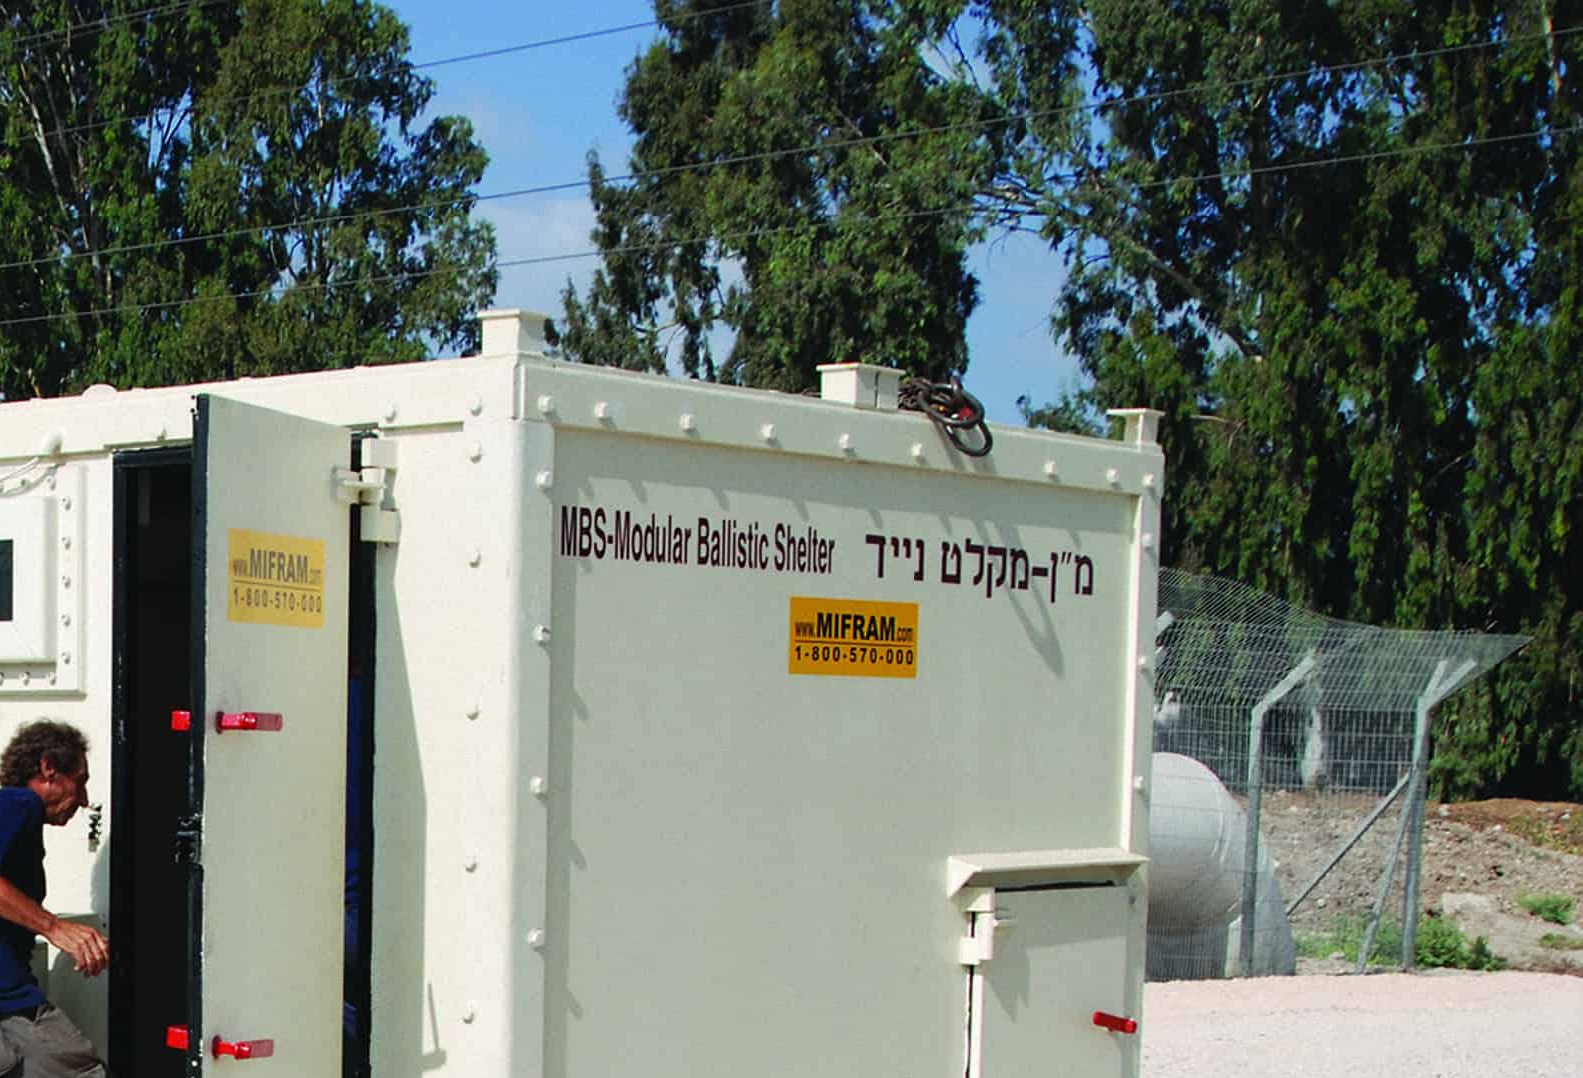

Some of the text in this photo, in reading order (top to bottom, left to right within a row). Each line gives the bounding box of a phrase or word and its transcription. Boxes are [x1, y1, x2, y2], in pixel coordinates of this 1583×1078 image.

[560, 504, 835, 574] MBS-Modular Ballistic Shelter
[865, 533, 925, 582] נייד
[795, 645, 914, 665] 1-800-570-000
